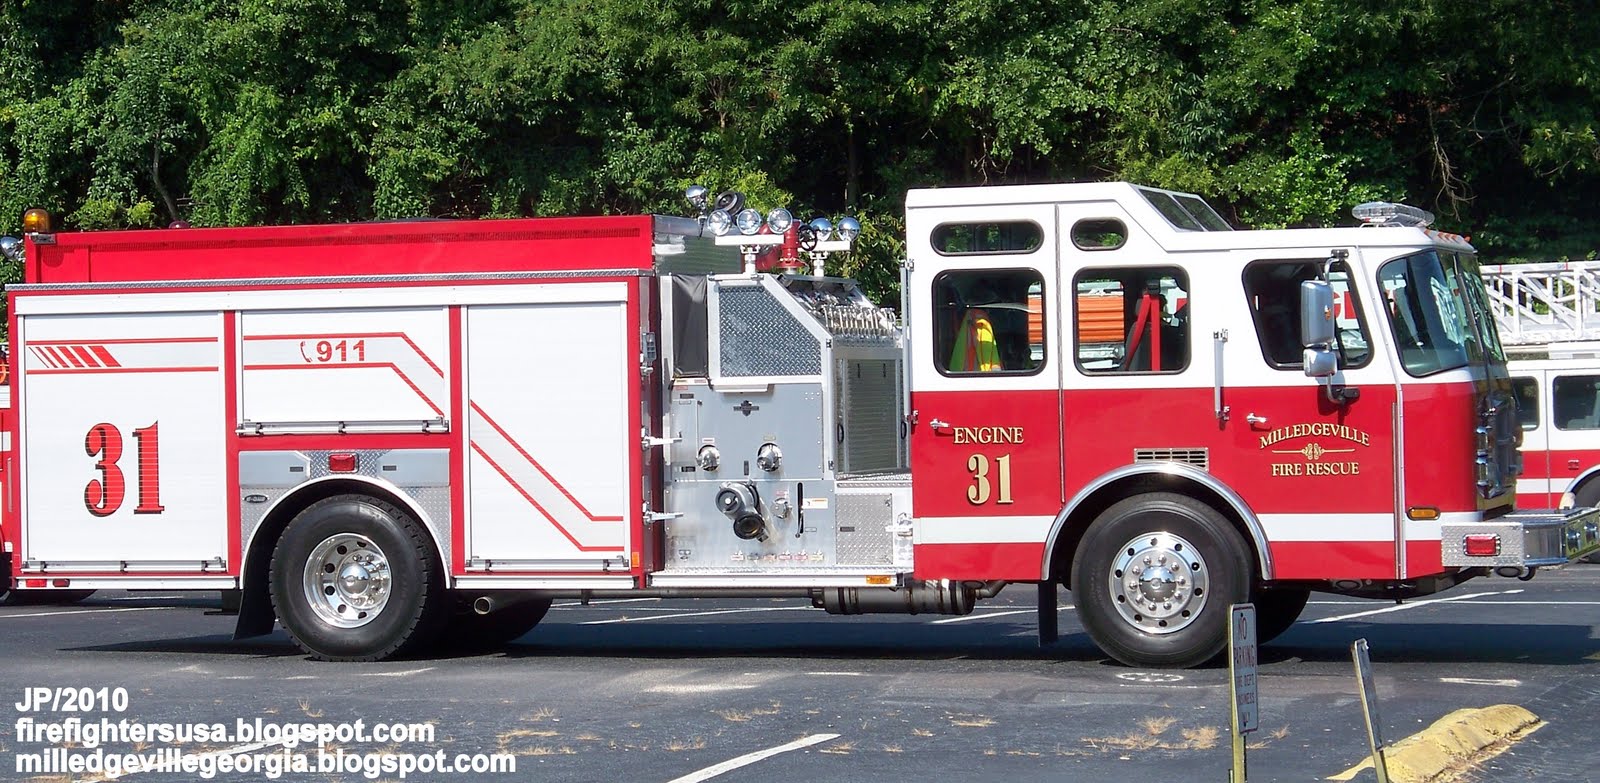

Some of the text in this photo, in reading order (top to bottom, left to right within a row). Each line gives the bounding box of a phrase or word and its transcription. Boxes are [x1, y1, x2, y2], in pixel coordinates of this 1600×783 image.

[315, 339, 366, 362] 911
[952, 426, 1025, 445] ENGINE
[1259, 422, 1371, 450] MILLEDGEVILLE
[83, 420, 165, 518] 31
[967, 453, 1014, 505] 31
[1271, 461, 1361, 478] FIRE RESCUE
